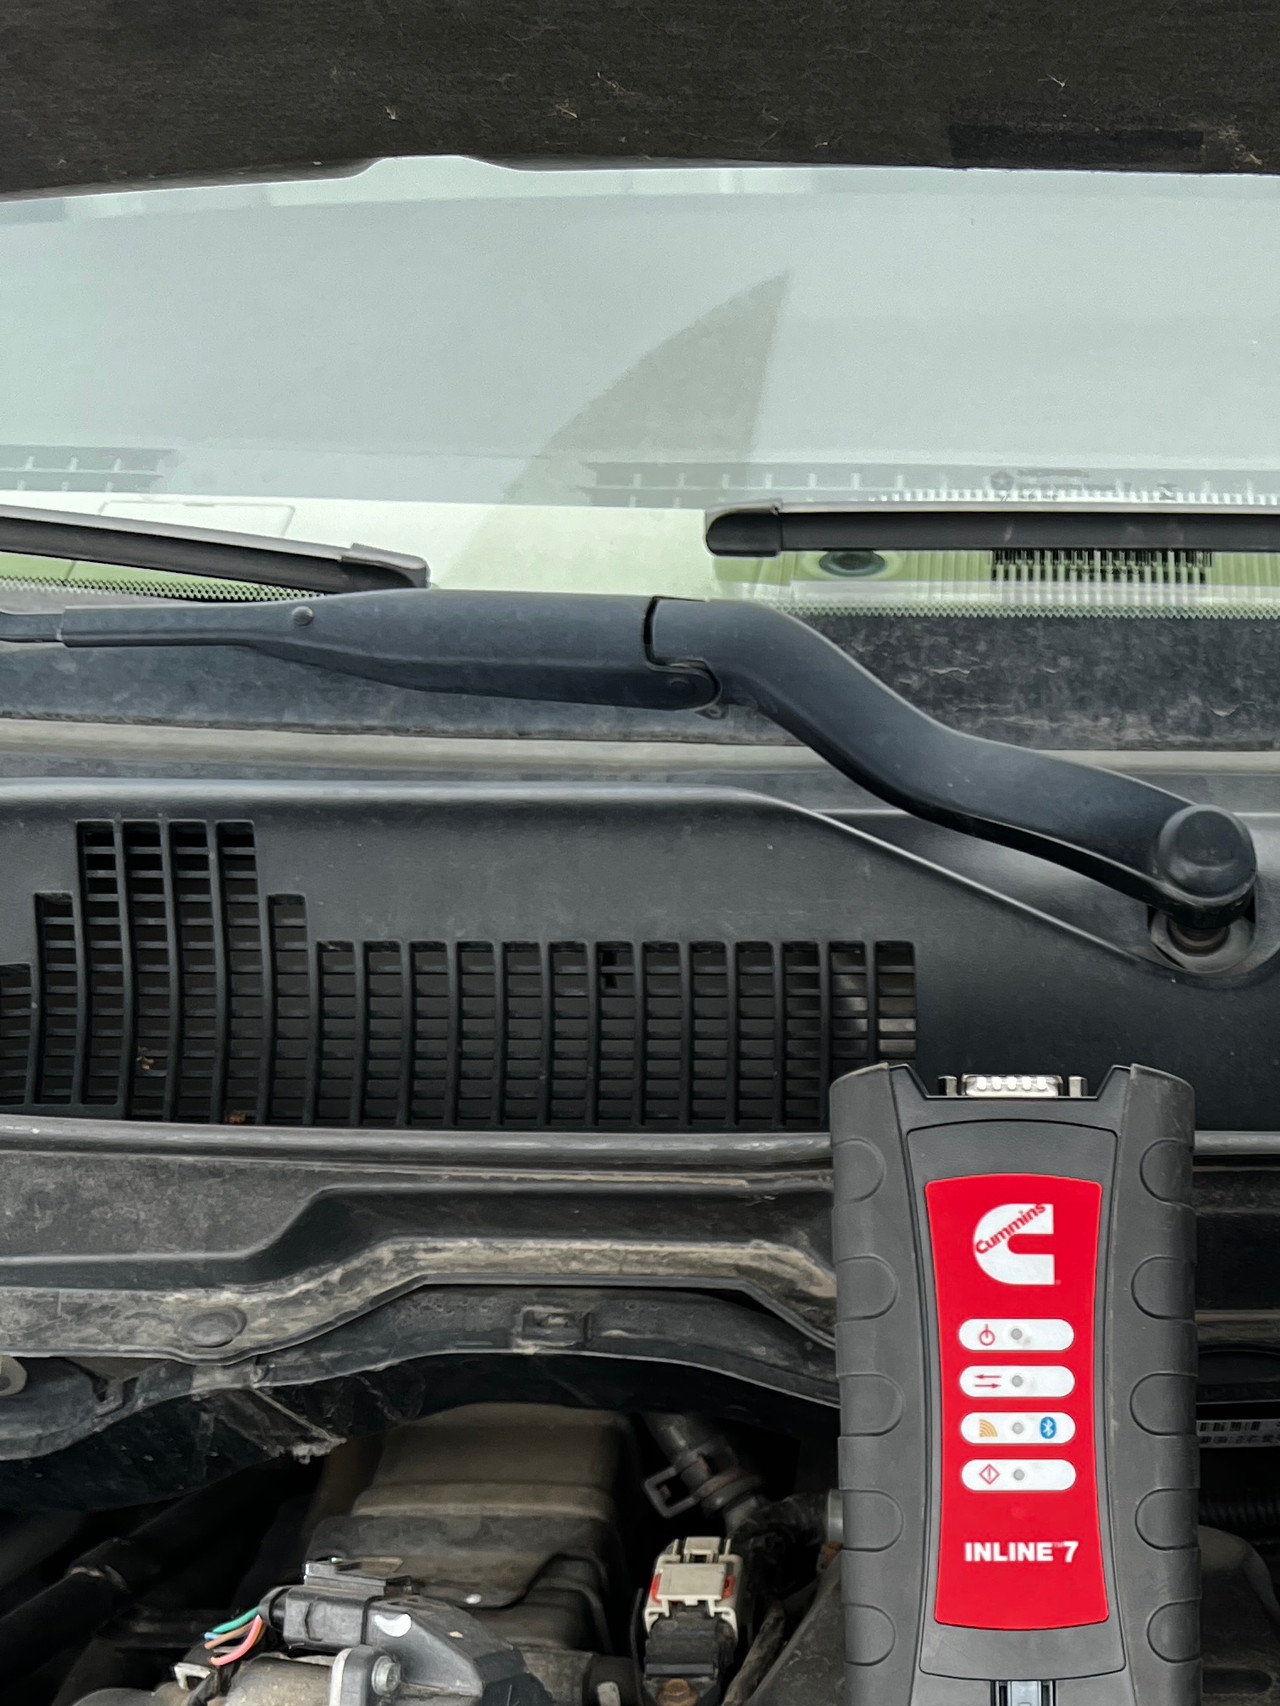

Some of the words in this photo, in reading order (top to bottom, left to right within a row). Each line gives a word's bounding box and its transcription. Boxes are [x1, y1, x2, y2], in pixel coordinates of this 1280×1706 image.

[975, 1203, 1046, 1254] Cummins
[965, 1541, 1054, 1562] INLINE
[1062, 1540, 1079, 1563] 7
